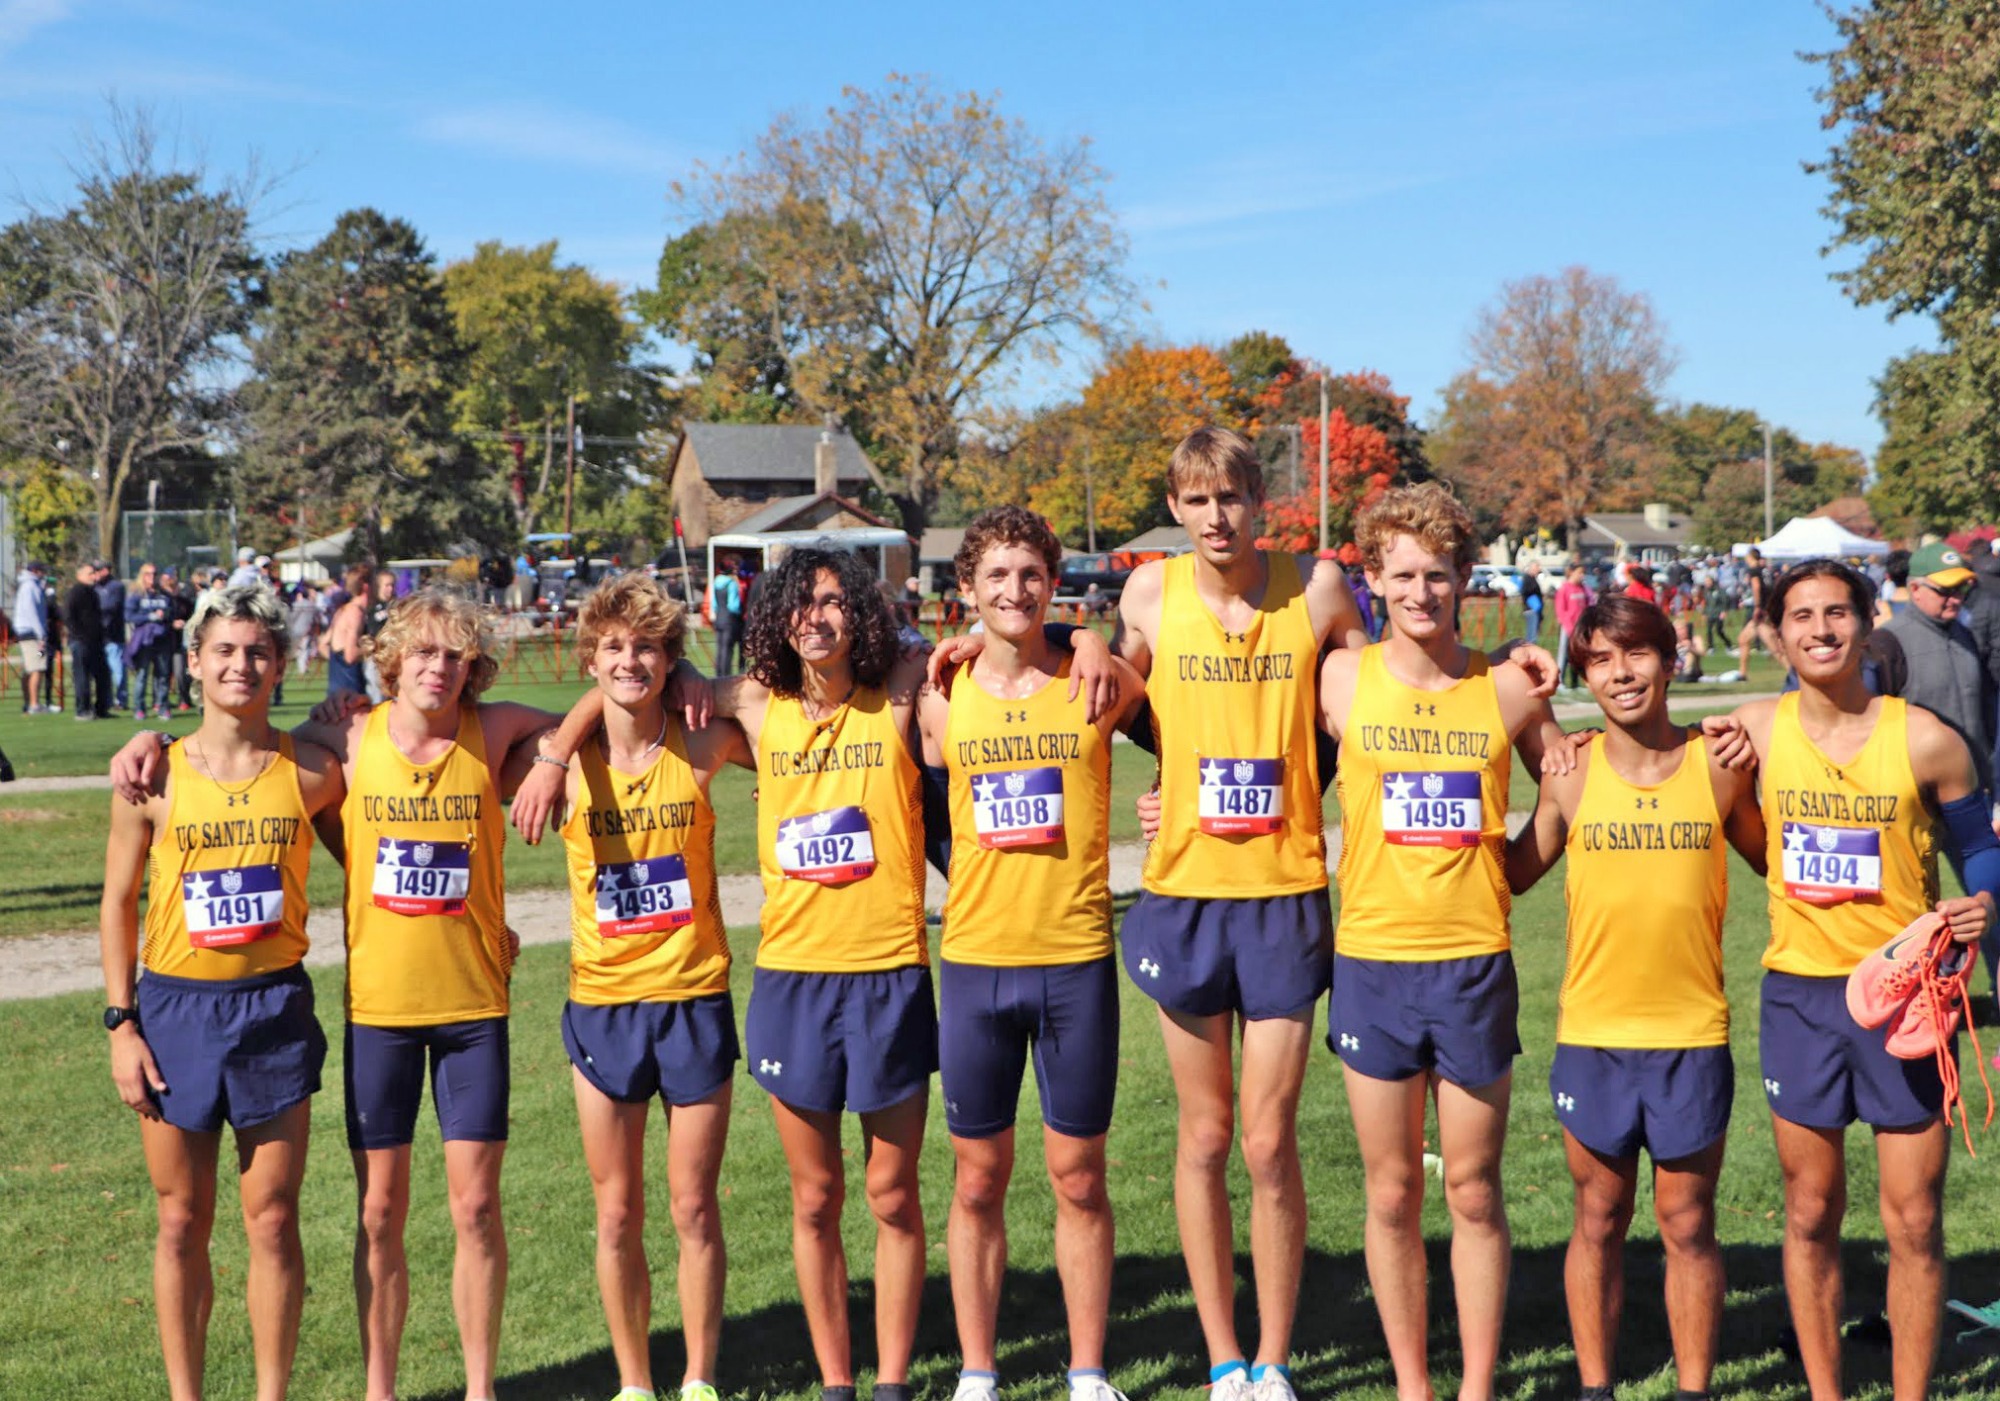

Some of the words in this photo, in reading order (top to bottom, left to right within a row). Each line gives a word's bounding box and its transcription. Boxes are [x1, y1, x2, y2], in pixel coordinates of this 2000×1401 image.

[1178, 654, 1198, 681] UC
[1203, 655, 1252, 682] SANTA
[1254, 652, 1293, 682] CRUZ
[958, 740, 978, 767] UC
[981, 735, 1035, 764] SANTA
[1038, 733, 1080, 760] CRUZ
[1362, 725, 1383, 752] UC
[1388, 726, 1442, 755] SANTA
[1446, 730, 1490, 759] CRUZ
[771, 752, 789, 777] UC
[793, 747, 841, 775] SANTA
[844, 742, 884, 770] CRUZ
[363, 795, 383, 822] UC
[387, 796, 440, 822] SANTA
[443, 794, 481, 821] CRUZ
[988, 797, 1049, 828] 1498
[1214, 788, 1272, 815] 1487
[1400, 800, 1466, 828] 1495
[1800, 790, 1851, 821] SANTA
[1854, 795, 1898, 822] CRUZ
[176, 824, 197, 852] UC
[202, 820, 256, 849] SANTA
[260, 817, 300, 845] CRUZ
[583, 810, 603, 838] UC
[604, 807, 657, 836] SANTA
[659, 801, 696, 830] CRUZ
[793, 835, 855, 867] 1492
[1583, 823, 1603, 851] UC
[1608, 822, 1666, 850] SANTA
[1670, 821, 1713, 850] CRUZ
[393, 869, 451, 896] 1497
[1796, 853, 1859, 885] 1494
[204, 895, 264, 926] 1491
[611, 885, 674, 918] 1493
